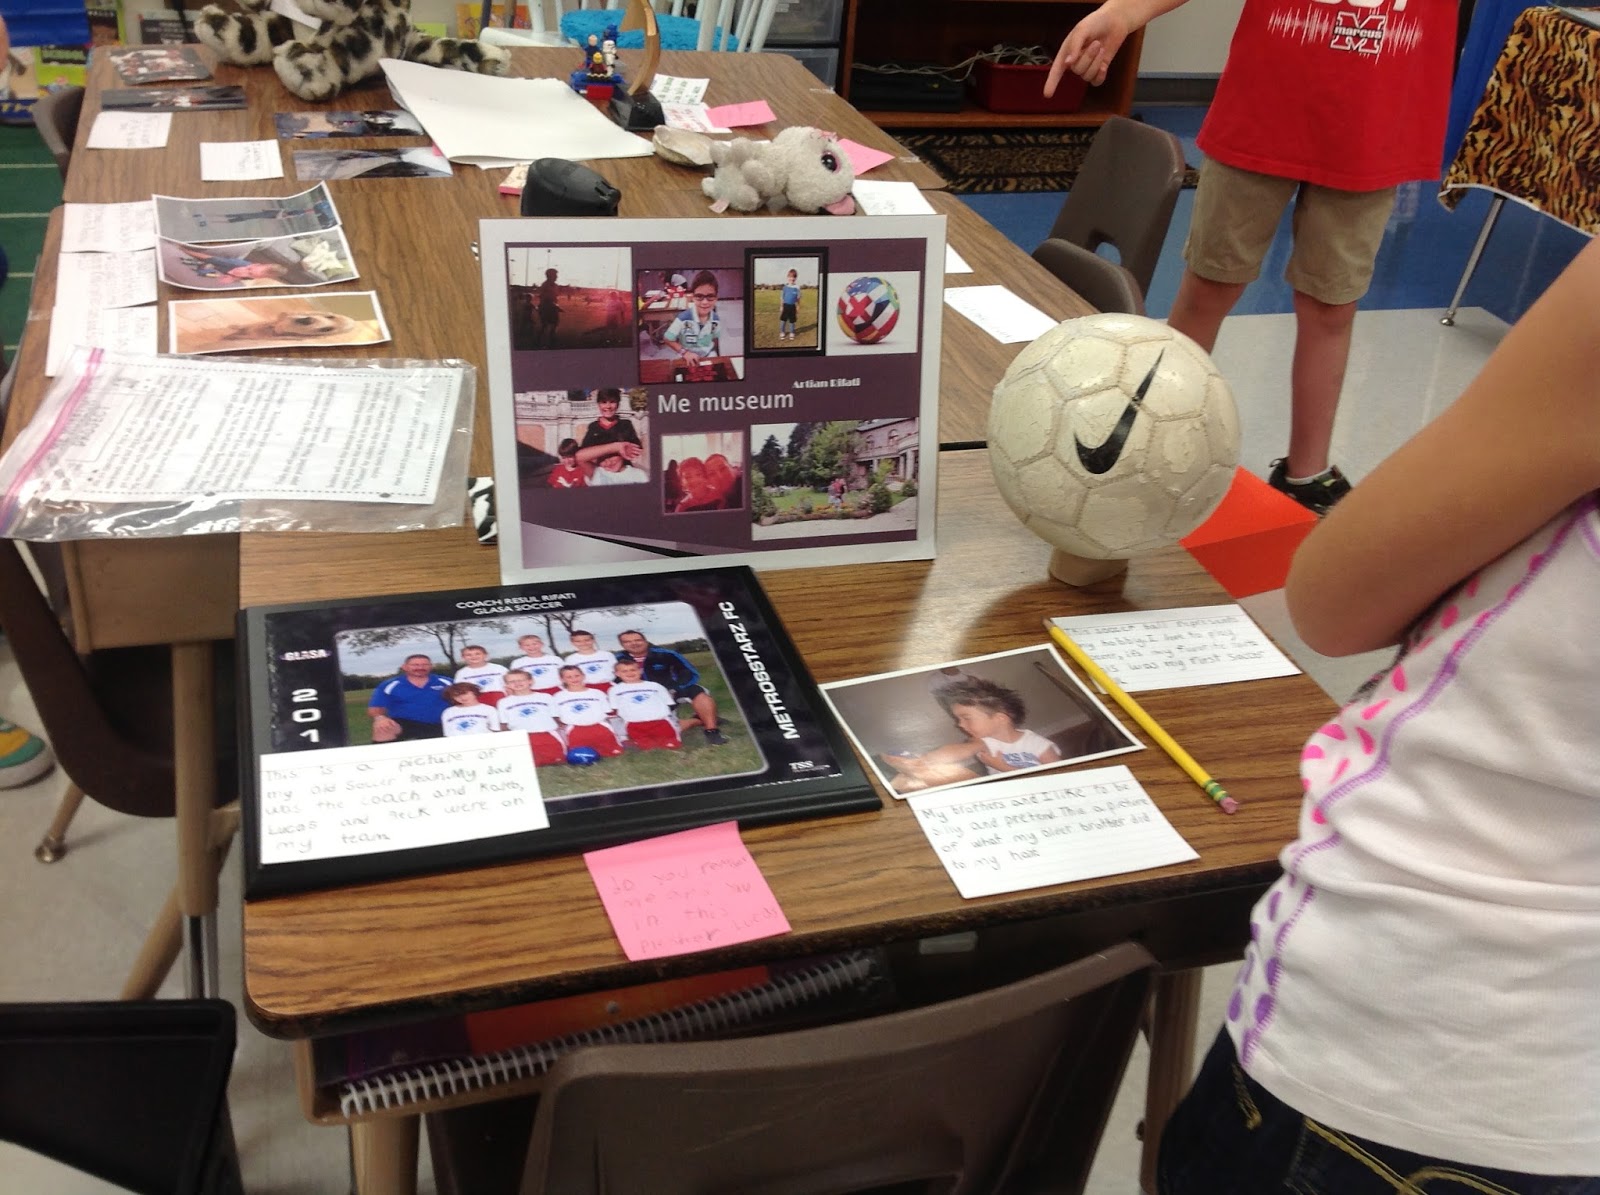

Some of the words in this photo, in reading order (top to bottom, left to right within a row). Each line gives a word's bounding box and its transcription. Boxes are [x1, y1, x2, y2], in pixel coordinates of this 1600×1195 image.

[1334, 26, 1383, 39] marcus
[792, 379, 829, 389] Artian
[657, 394, 691, 413] Me
[699, 393, 794, 412] museum
[455, 599, 503, 609] COACH
[472, 605, 514, 615] GLASA
[514, 601, 564, 612] SOCCER
[718, 601, 740, 620] FC
[1128, 661, 1160, 671] was
[1164, 659, 1187, 671] my
[266, 769, 298, 781] This
[320, 765, 334, 775] is
[356, 763, 375, 771] a
[398, 753, 463, 771] picture
[478, 748, 497, 760] of
[267, 790, 293, 801] my
[310, 783, 337, 795] old
[487, 763, 513, 775] dad
[317, 801, 344, 809] the
[361, 790, 421, 805] coach
[433, 785, 466, 799] and
[921, 808, 949, 824] My
[950, 800, 1006, 815] brothers
[1011, 794, 1039, 807] and
[1040, 791, 1054, 801] I
[267, 820, 318, 836] Lucas
[340, 815, 369, 827] and
[444, 801, 489, 814] were
[501, 797, 524, 807] on
[932, 825, 965, 839] silly
[969, 817, 1000, 831] and
[940, 841, 959, 853] of
[971, 833, 1003, 849] what
[1013, 832, 1039, 846] my
[1078, 817, 1126, 832] brother
[1130, 811, 1151, 824] did
[276, 839, 313, 854] my
[342, 832, 392, 845] team
[951, 859, 967, 870] to
[975, 855, 1001, 871] my
